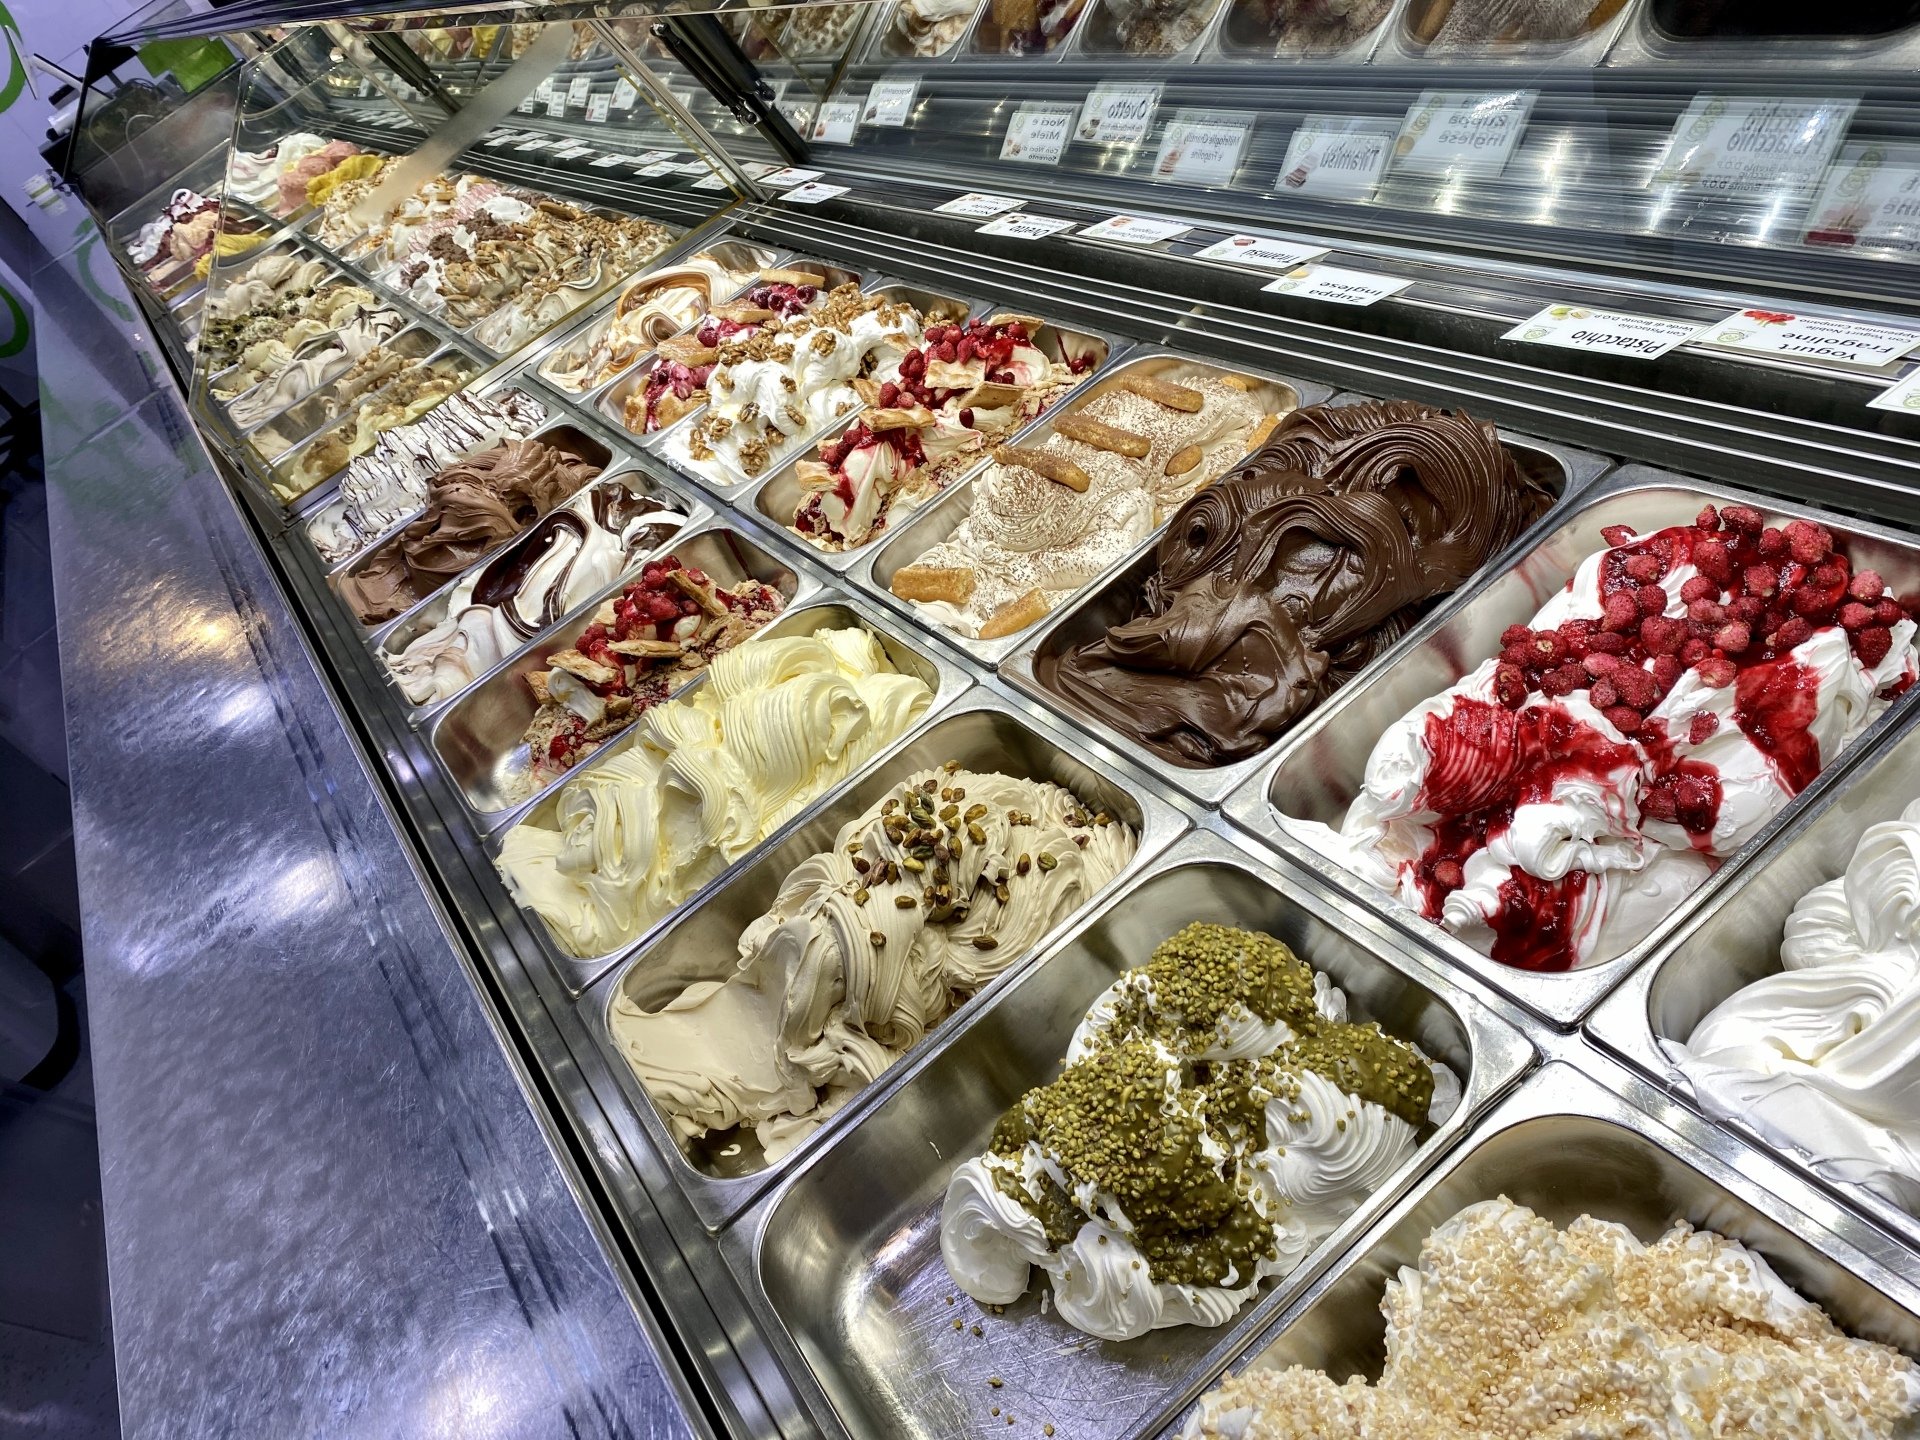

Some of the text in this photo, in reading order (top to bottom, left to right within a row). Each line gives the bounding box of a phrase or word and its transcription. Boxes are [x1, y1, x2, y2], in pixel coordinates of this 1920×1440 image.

[1308, 288, 1367, 303] Zuppa
[1318, 281, 1384, 297] Inglese
[1617, 323, 1687, 337] Con Pistacchio
[1620, 317, 1654, 327] Bronte
[1666, 323, 1694, 333] Verde
[1798, 318, 1919, 340] Appennino Campano
[1570, 330, 1667, 354] Pistacchio
[1780, 332, 1895, 354] Fragoline
[1805, 325, 1912, 344] Con Yogurt Nobile
[1778, 343, 1858, 361] Yogurt
